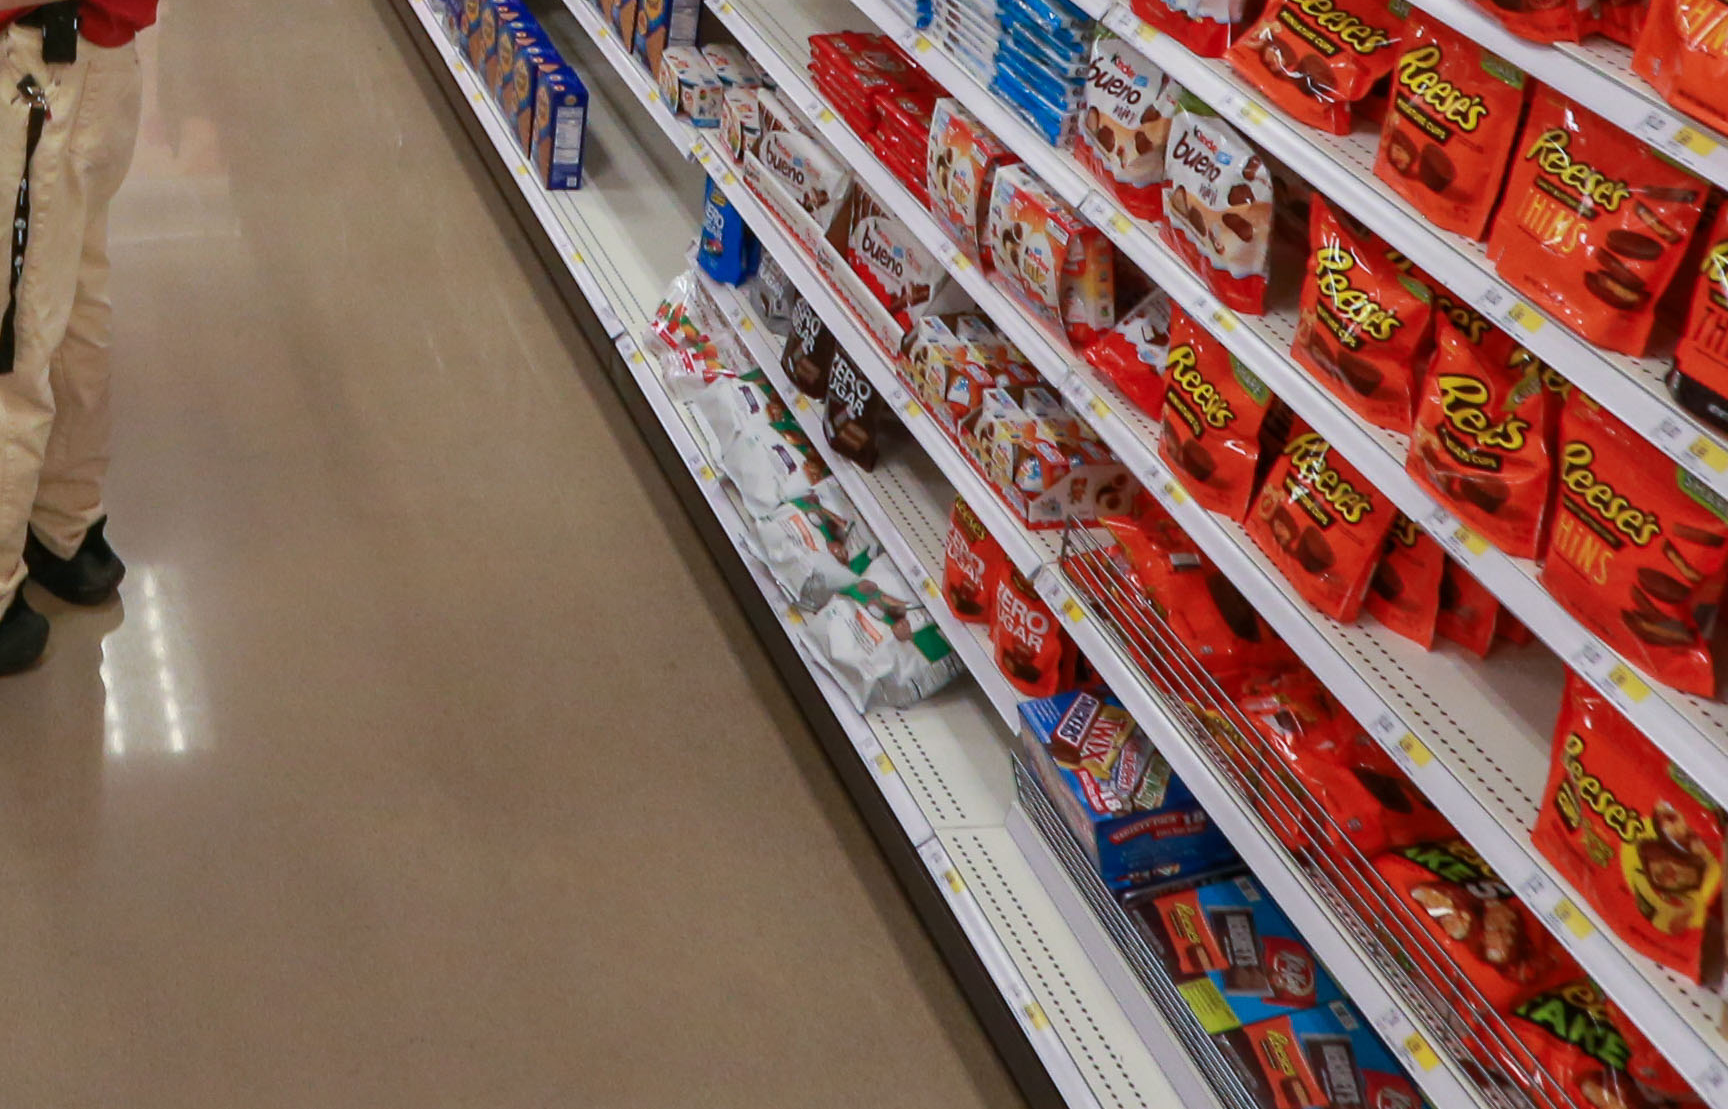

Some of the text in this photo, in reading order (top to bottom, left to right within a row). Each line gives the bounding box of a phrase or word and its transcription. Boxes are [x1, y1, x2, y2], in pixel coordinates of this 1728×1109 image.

[1085, 56, 1141, 108] bueno
[1398, 46, 1487, 133] Reese's
[766, 141, 805, 186] bueno
[1172, 135, 1220, 184] bueno
[1525, 129, 1630, 213] Reese's
[861, 232, 904, 278] bueno
[1285, 432, 1373, 527] Reese's
[1563, 441, 1663, 548] Reese's
[995, 607, 1044, 654] UGAR
[1058, 695, 1099, 745] SNICKERS
[1083, 718, 1129, 764] TWIX
